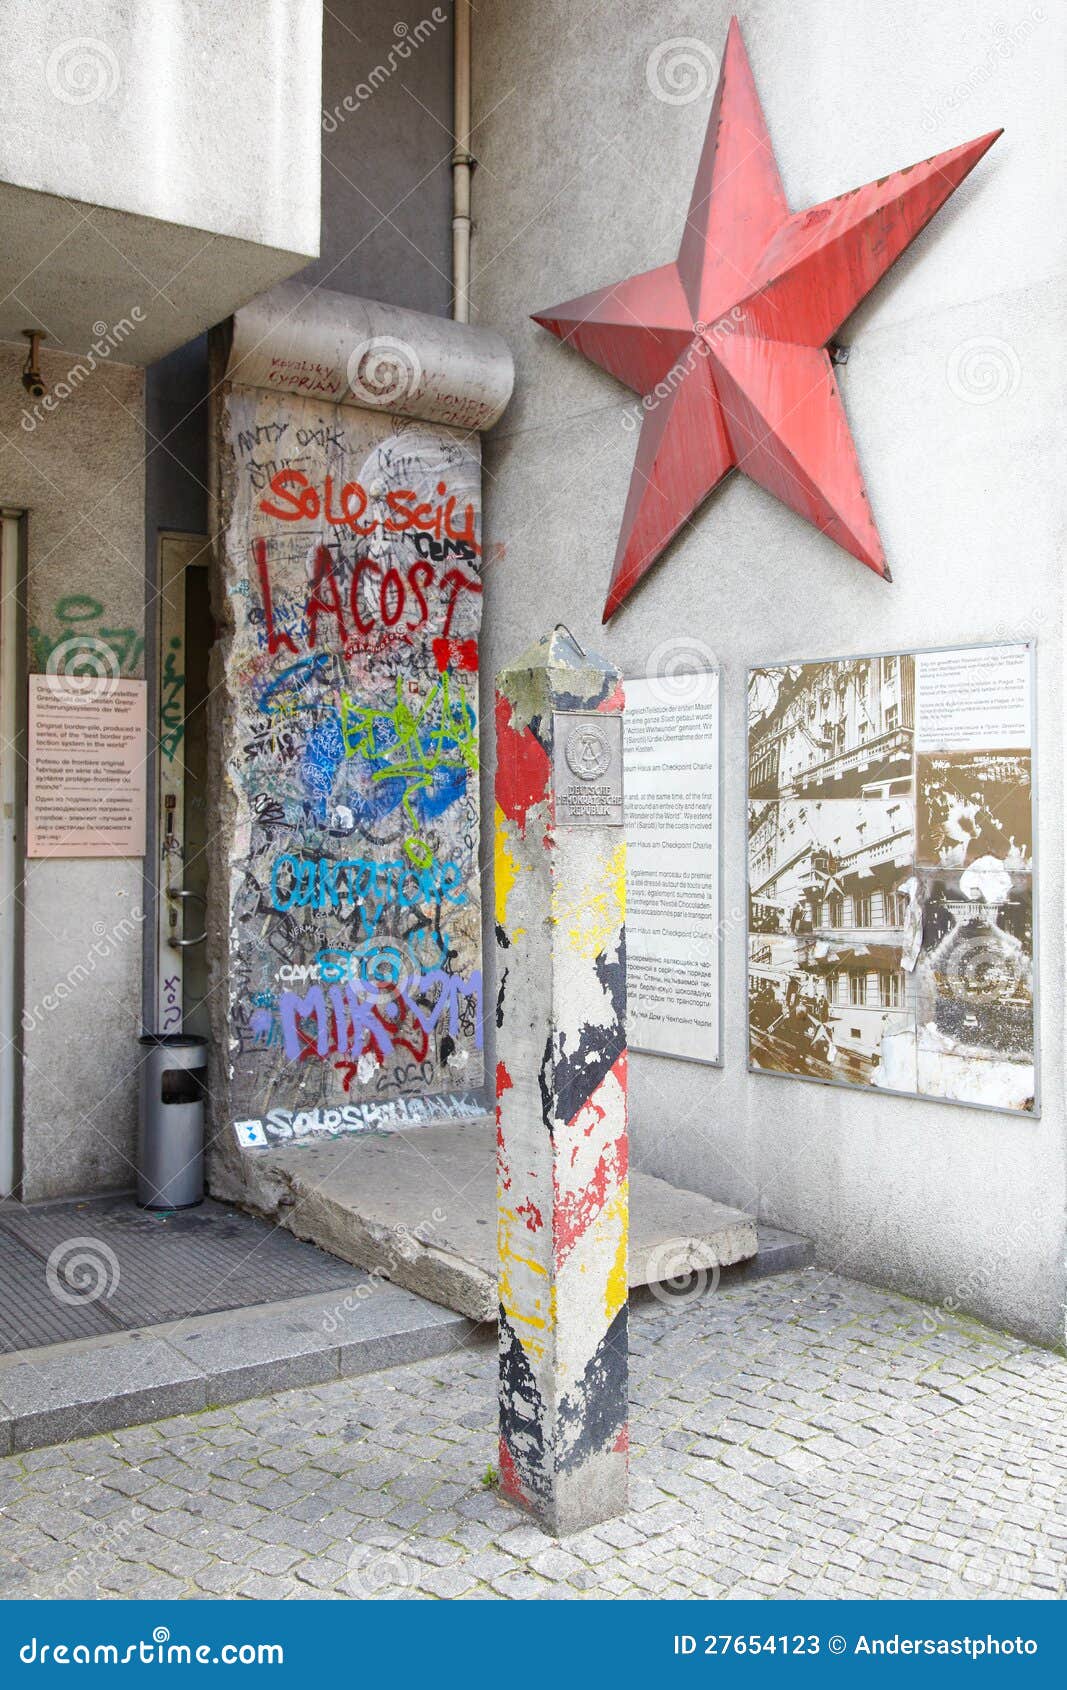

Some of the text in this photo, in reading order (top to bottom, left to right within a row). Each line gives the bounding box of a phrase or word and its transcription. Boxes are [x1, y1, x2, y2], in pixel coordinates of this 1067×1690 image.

[662, 762, 692, 772] Checkpoint
[693, 762, 712, 770] Charlie
[569, 804, 611, 817] REPUBLIK
[662, 841, 692, 850] Checkpoint
[693, 841, 712, 850] Charlie
[662, 928, 692, 939] Checkpoint
